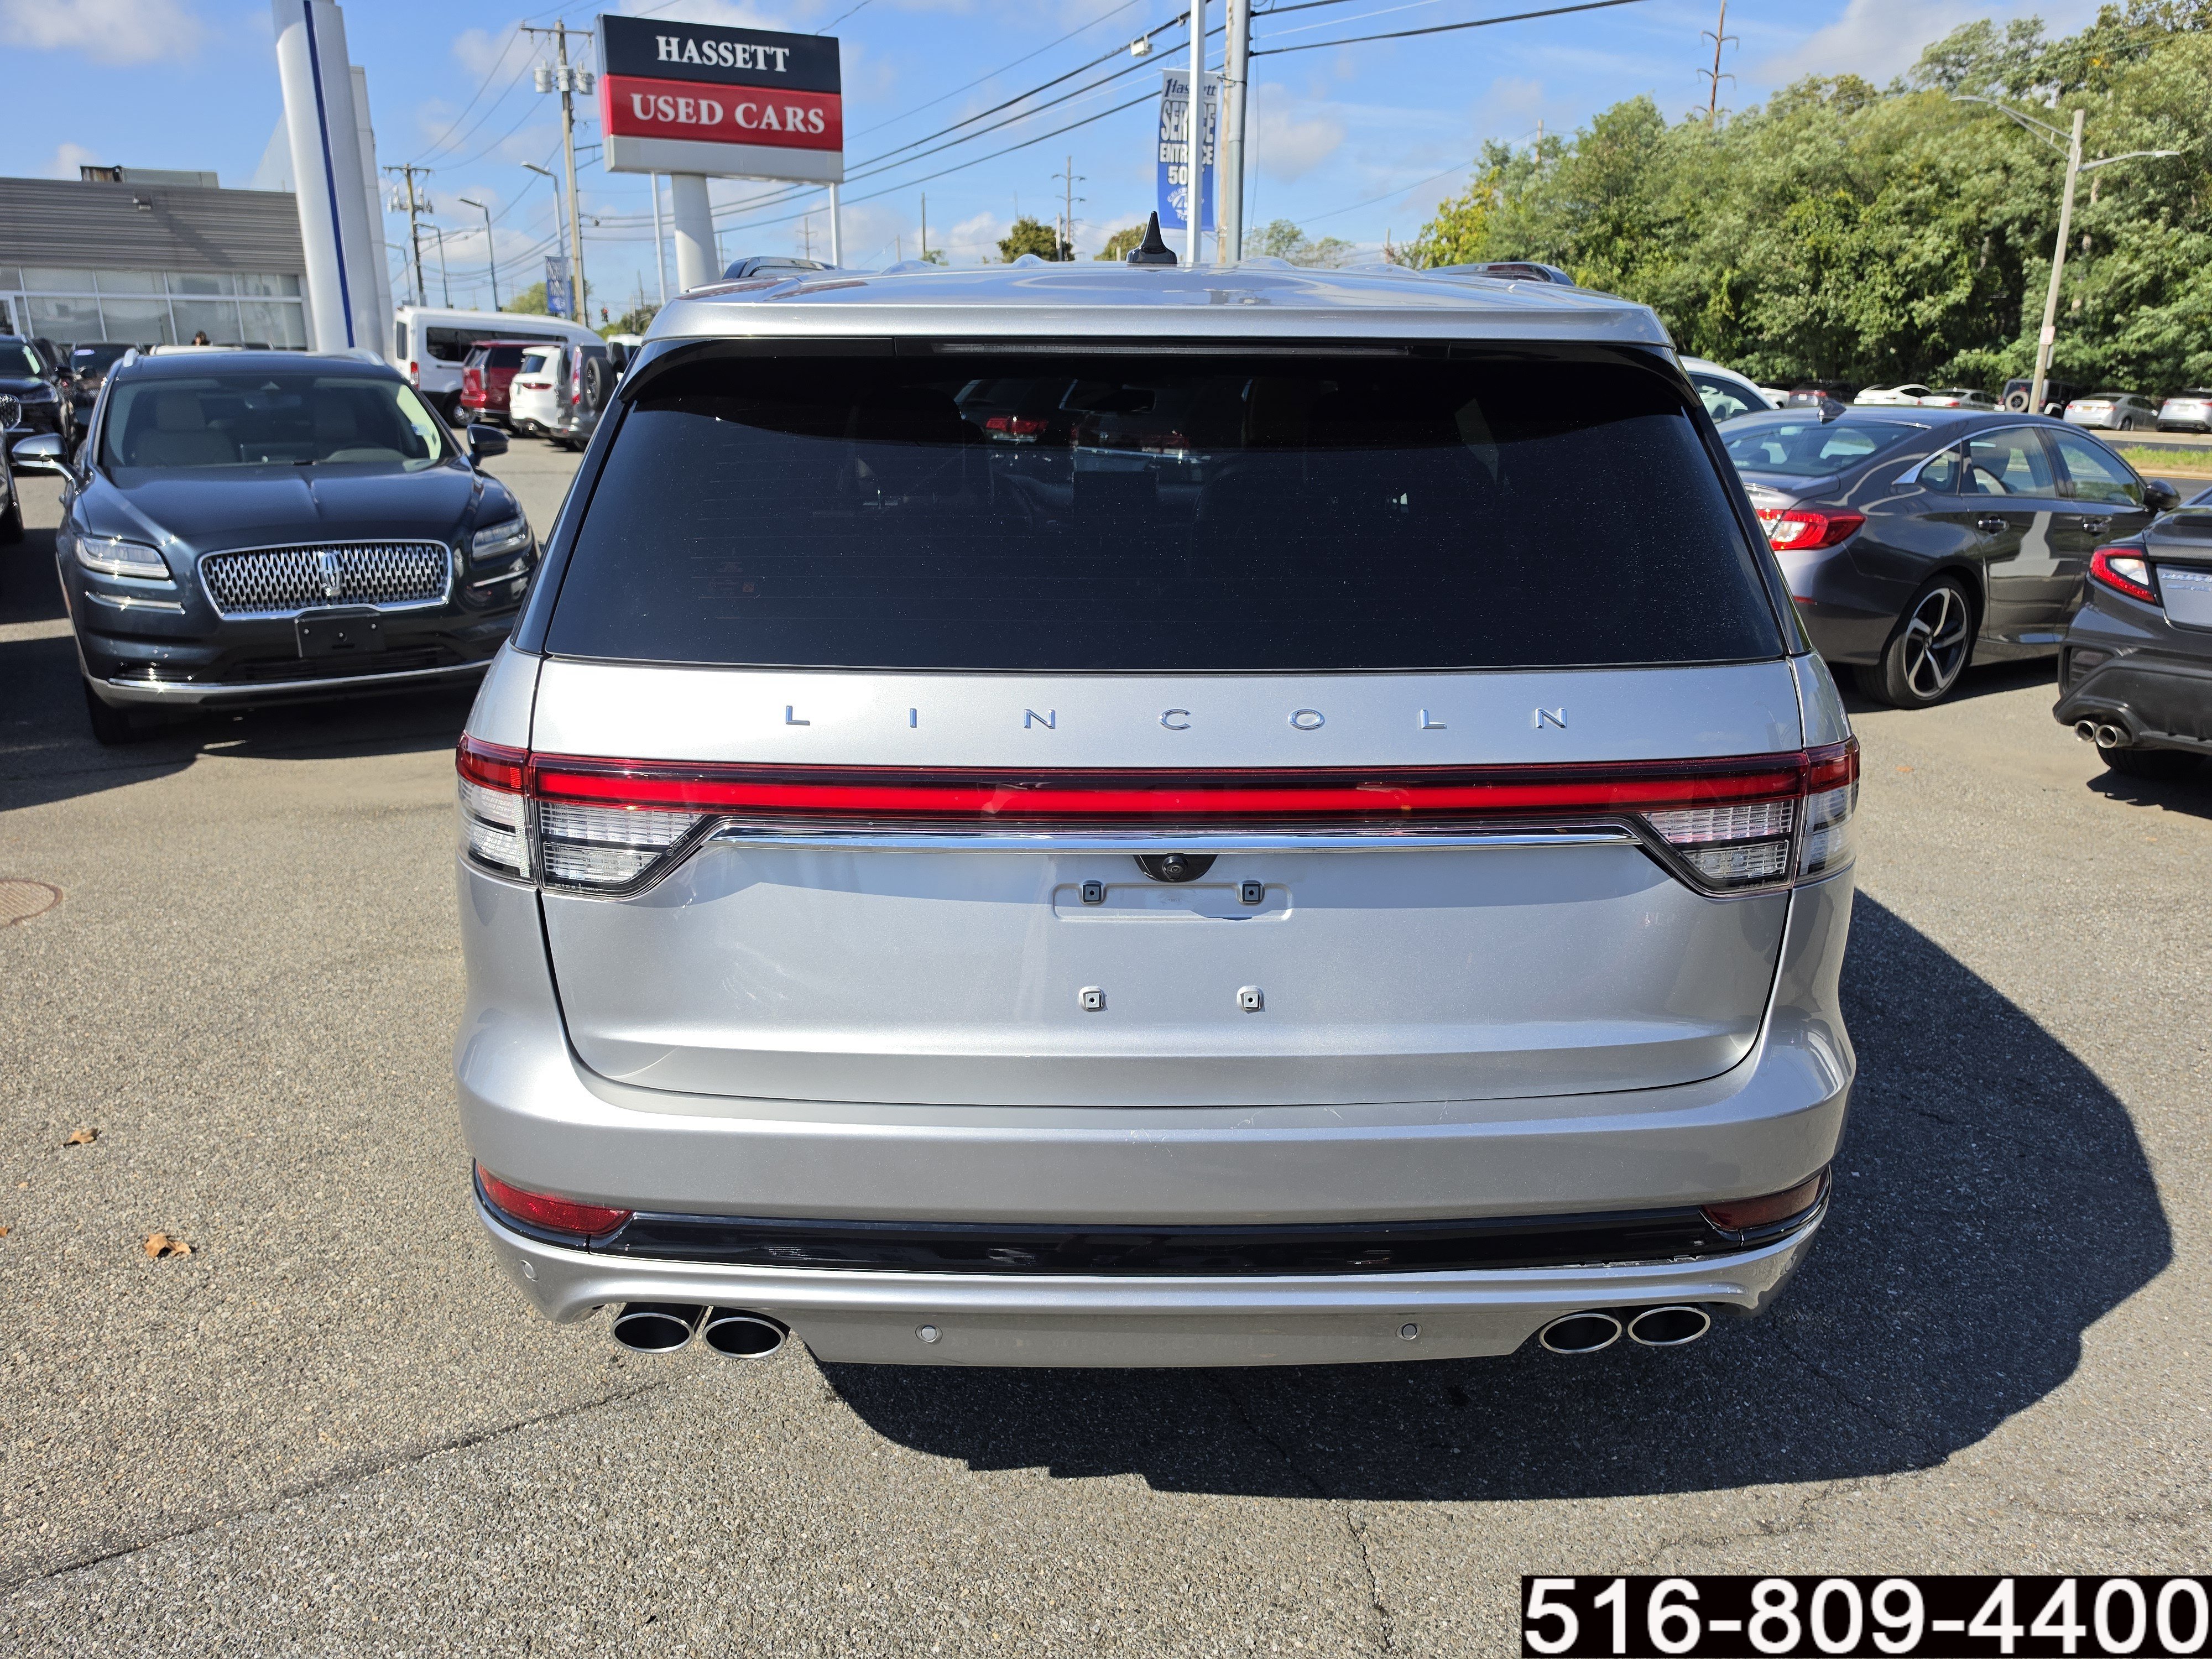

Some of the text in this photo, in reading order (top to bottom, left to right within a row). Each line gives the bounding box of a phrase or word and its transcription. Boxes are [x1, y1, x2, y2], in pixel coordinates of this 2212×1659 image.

[655, 35, 789, 72] HASSETT
[1165, 79, 1217, 97] Hastt
[630, 93, 825, 134] USED CARS
[1161, 101, 1215, 143] SERE
[1160, 143, 1213, 165] ENTRCE
[785, 705, 1567, 731] LINCOLN
